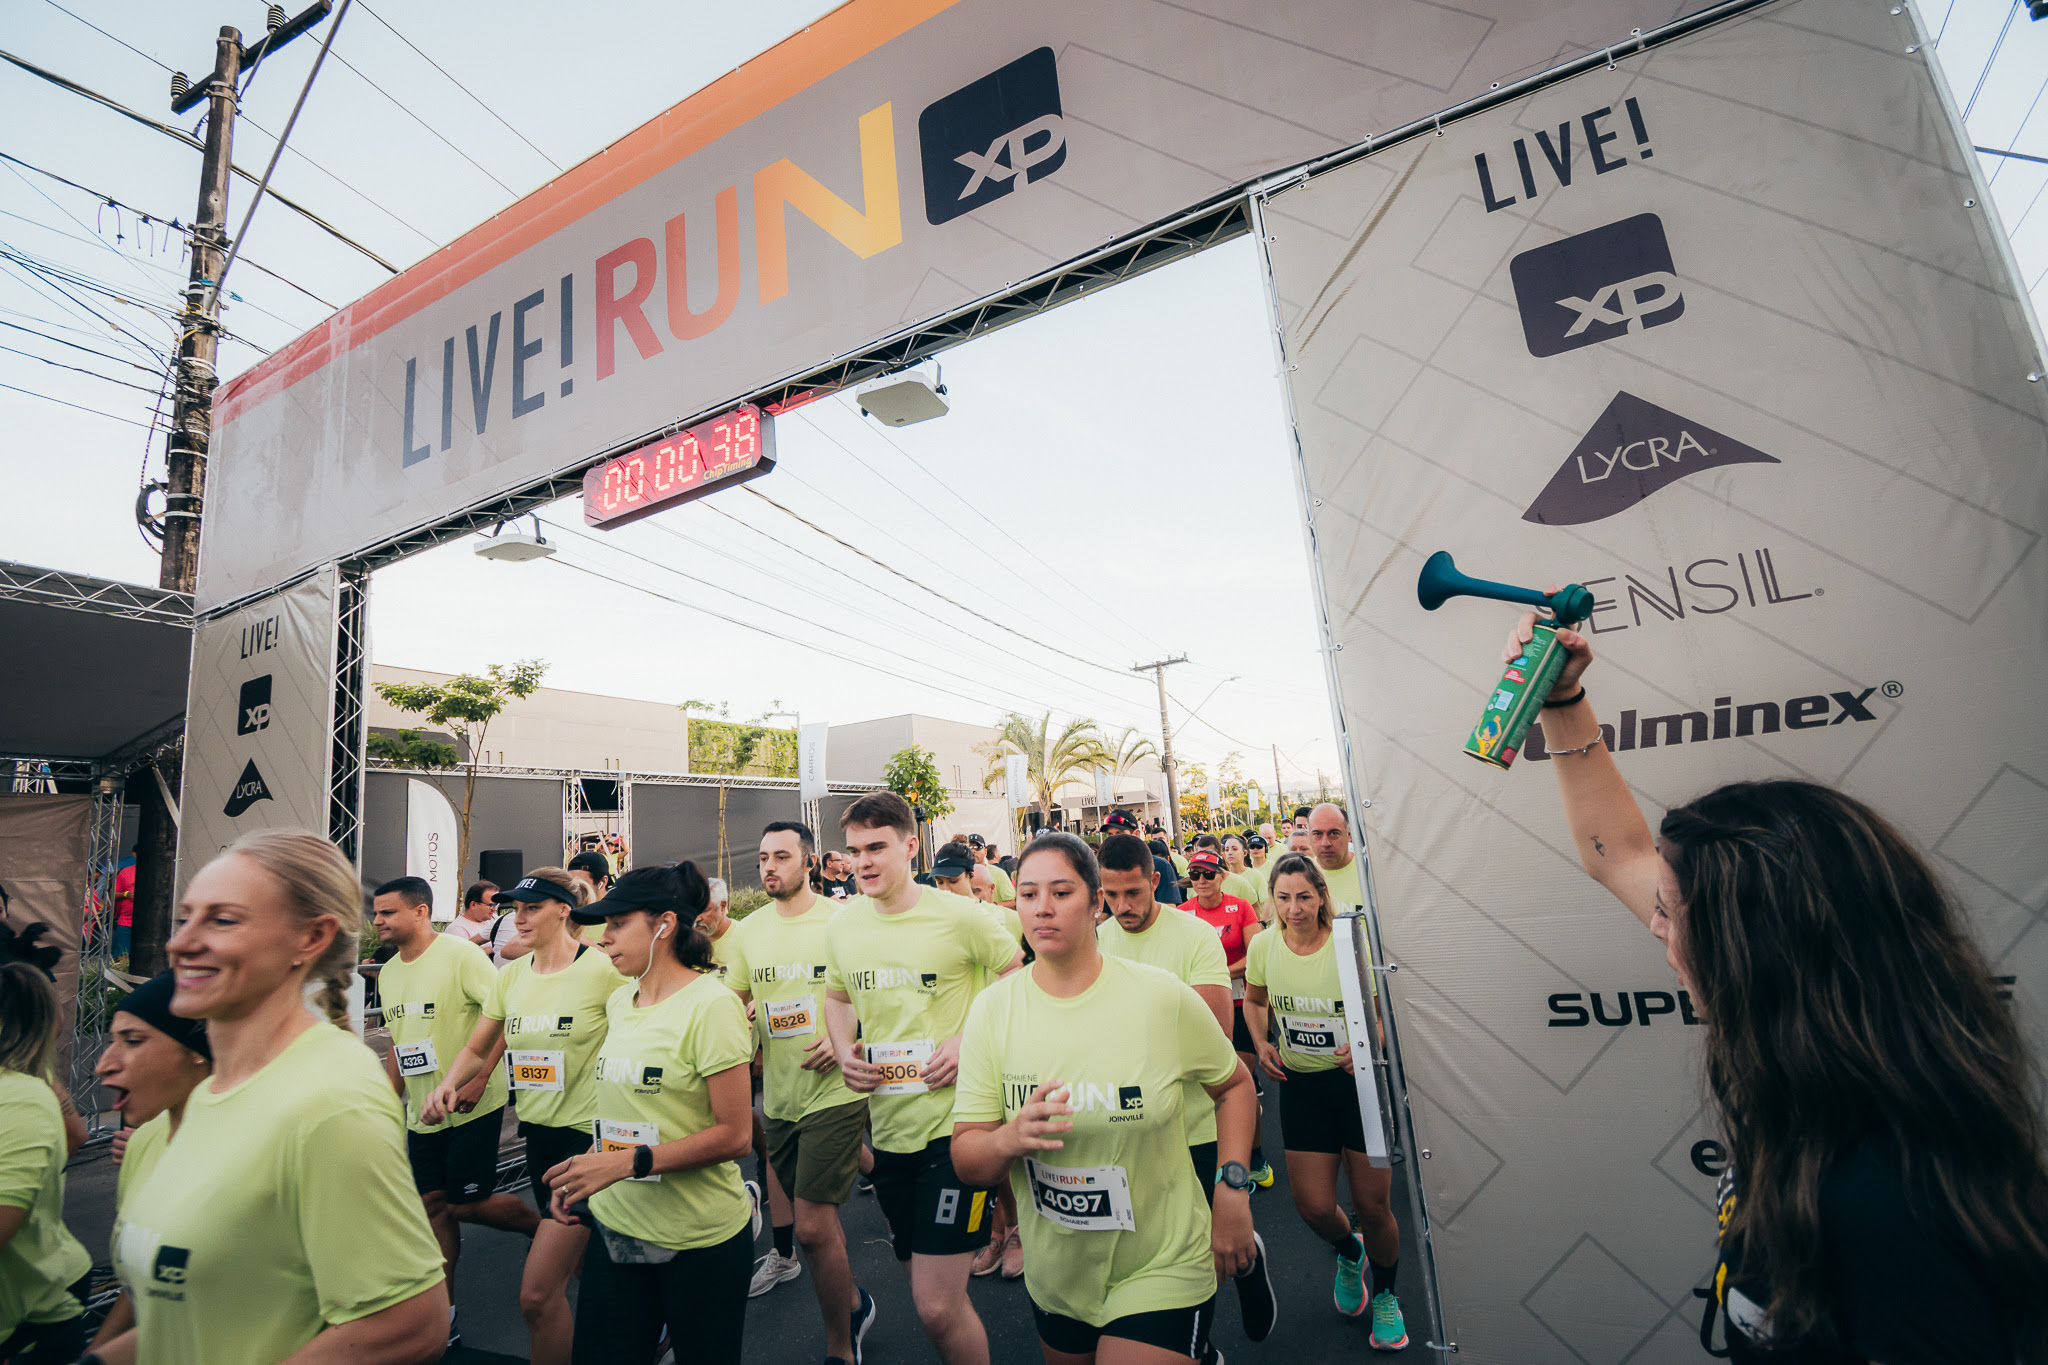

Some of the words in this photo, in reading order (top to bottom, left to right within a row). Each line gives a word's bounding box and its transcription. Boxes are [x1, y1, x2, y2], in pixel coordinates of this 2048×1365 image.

[1474, 97, 1654, 213] LIVE!
[595, 100, 902, 382] RUN
[1577, 430, 1709, 484] LYCRA
[703, 456, 753, 481] ChipTiming
[241, 615, 279, 659] LIVE!
[808, 741, 816, 782] CARROS
[236, 780, 263, 799] LYCRA
[428, 832, 439, 882] MOTOS
[521, 1013, 558, 1034] RUN
[772, 1013, 807, 1029] 8528
[1296, 1032, 1327, 1046] 4110
[403, 1055, 425, 1067] 4326
[521, 1067, 549, 1079] 8137
[1002, 1073, 1038, 1083] SCHAIENE
[1108, 1113, 1144, 1123] JOINVILLE
[1059, 1175, 1086, 1185] RUN
[1044, 1189, 1103, 1213] 4097
